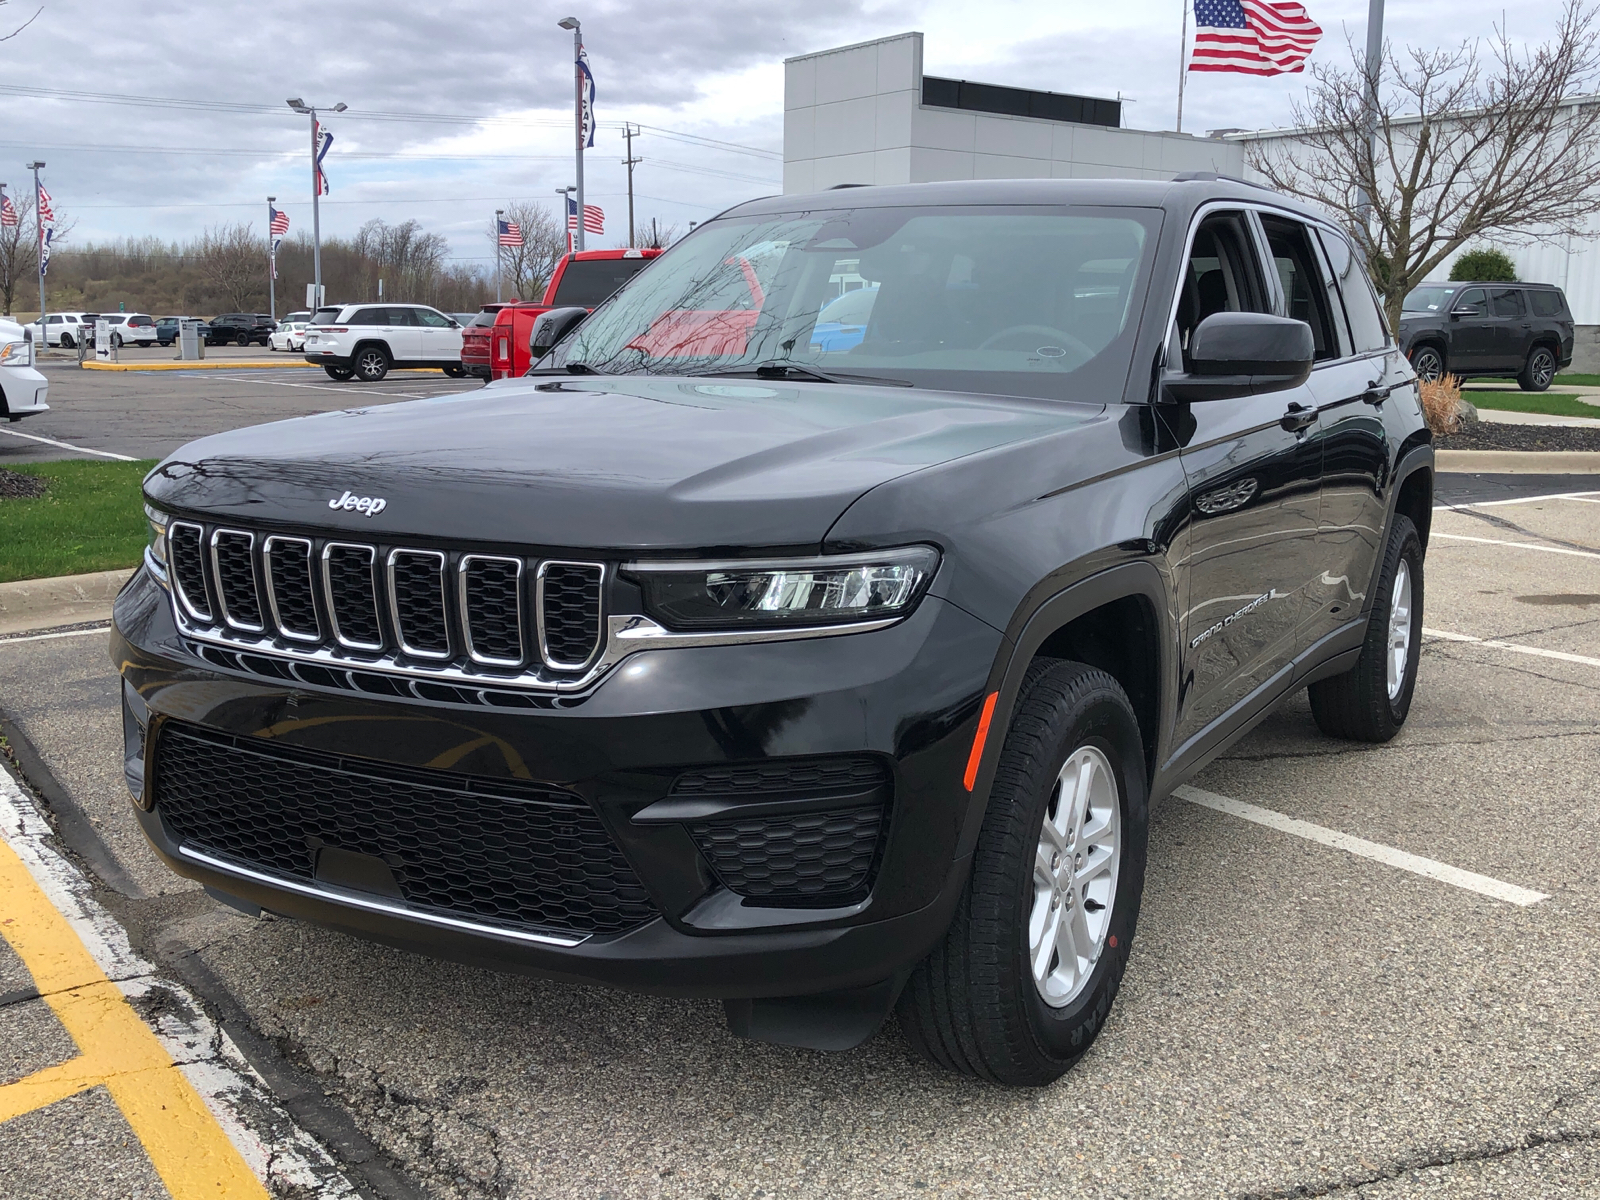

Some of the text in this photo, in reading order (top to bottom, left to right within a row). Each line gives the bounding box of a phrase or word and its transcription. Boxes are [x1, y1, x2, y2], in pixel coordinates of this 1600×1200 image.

[328, 490, 387, 518] Jeep
[1191, 593, 1269, 649] GRAND CHEROKEE
